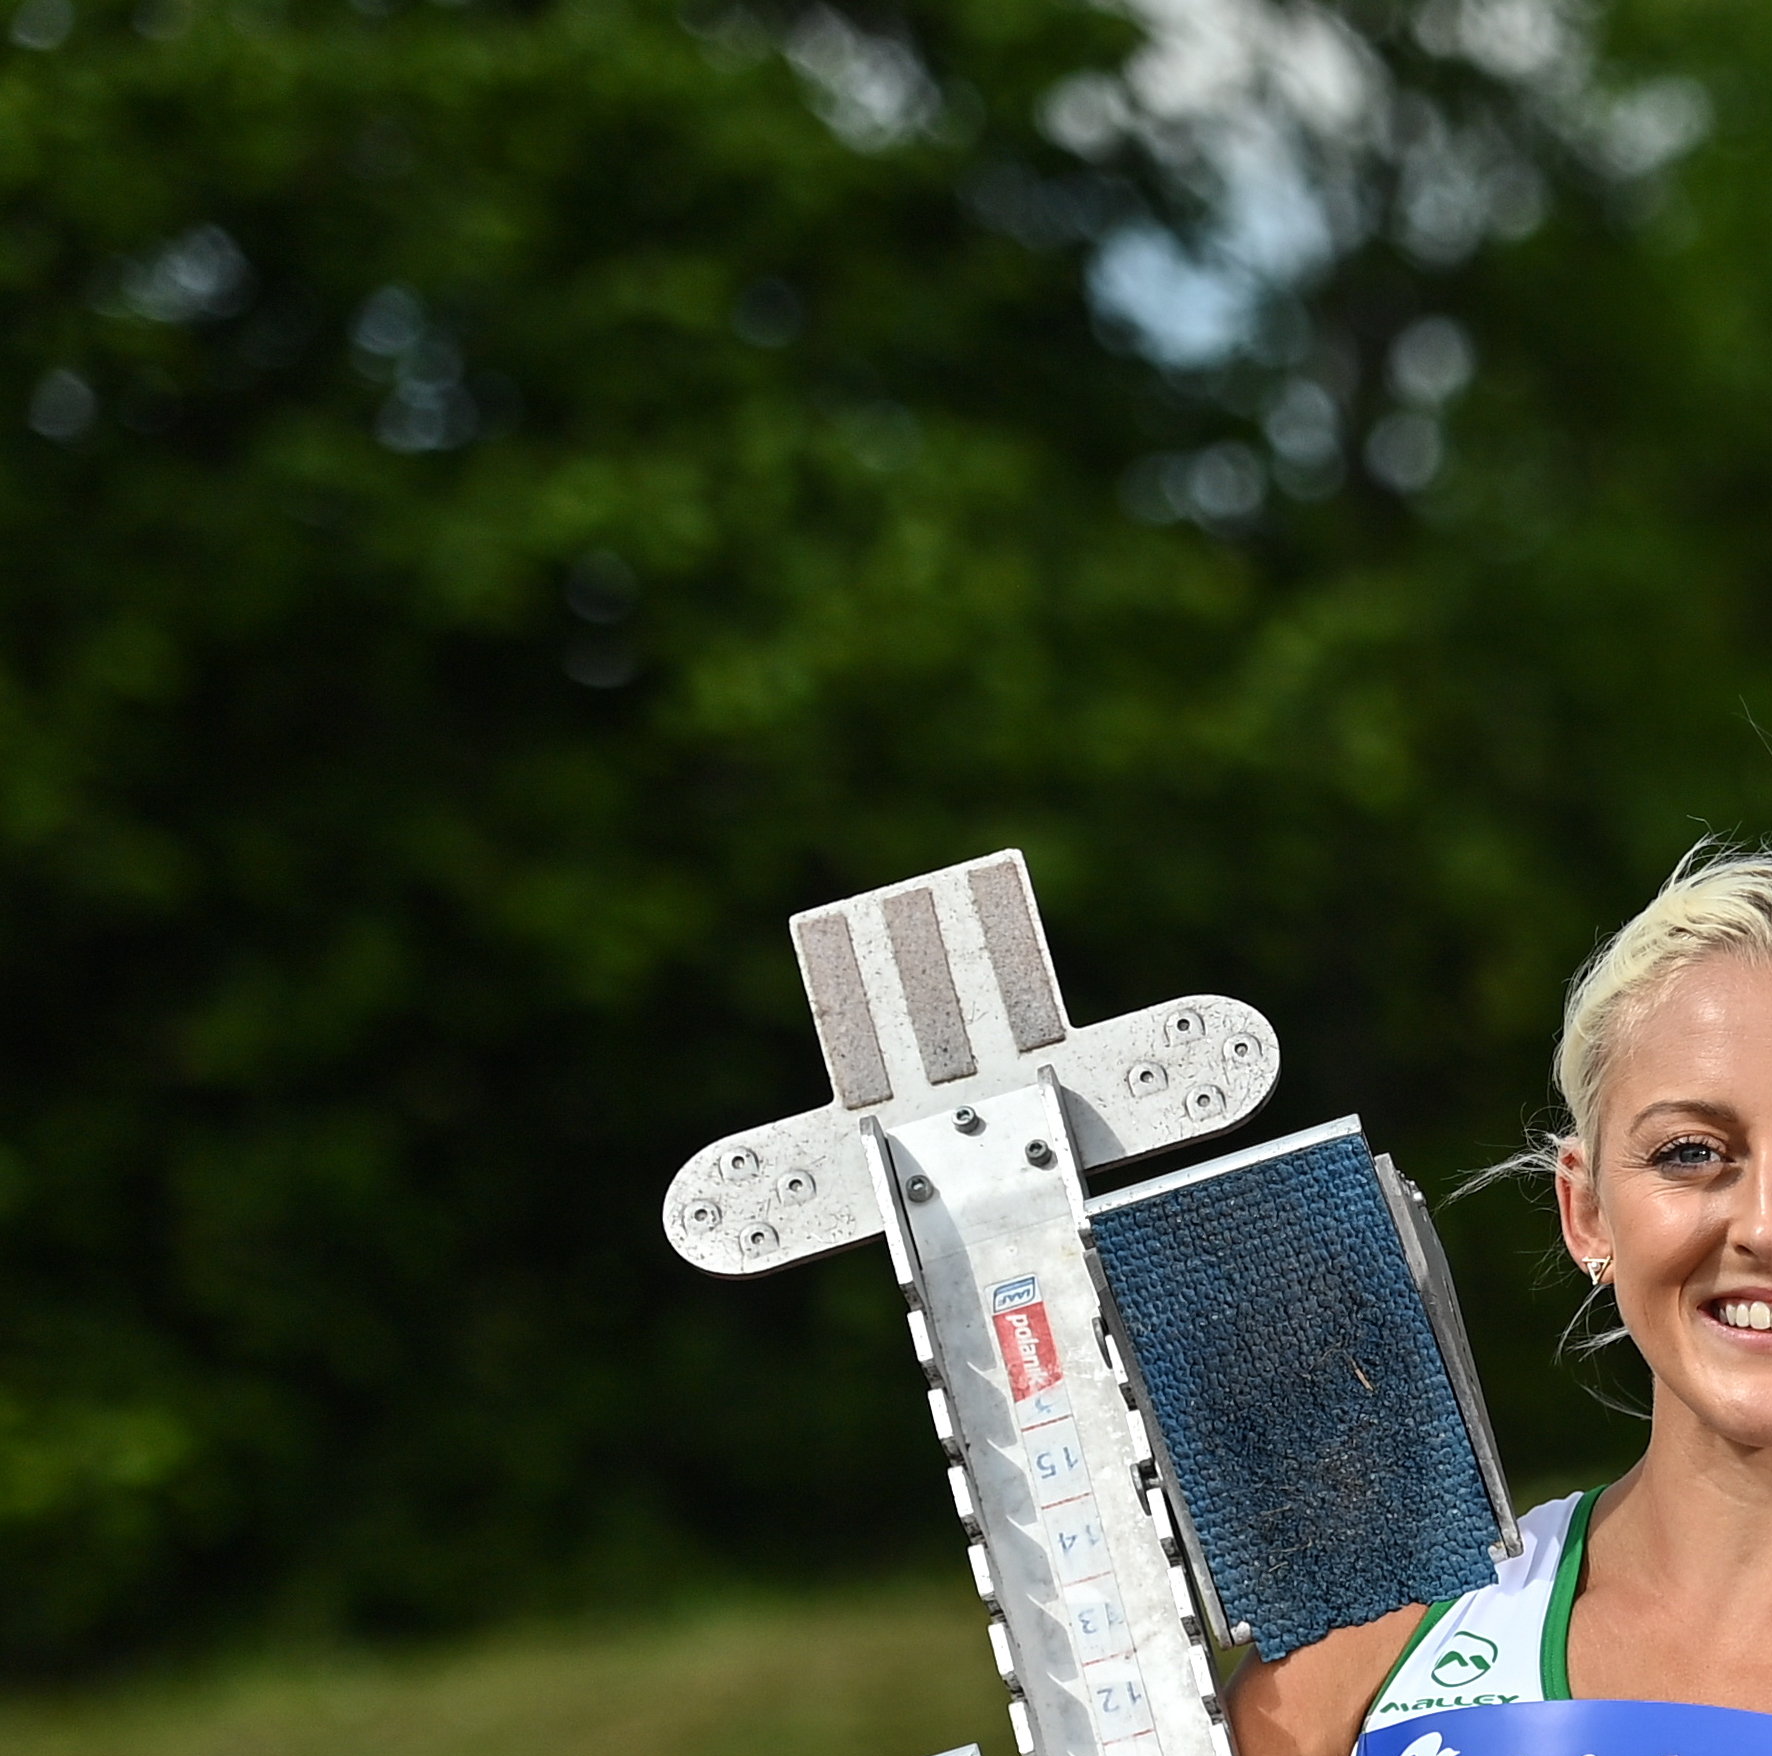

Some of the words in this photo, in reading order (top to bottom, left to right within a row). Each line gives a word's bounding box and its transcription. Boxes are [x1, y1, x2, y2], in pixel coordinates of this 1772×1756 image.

[1036, 1446, 1079, 1479] 15
[1058, 1524, 1099, 1552] 14
[1078, 1602, 1124, 1635] 13
[1097, 1681, 1142, 1713] 12
